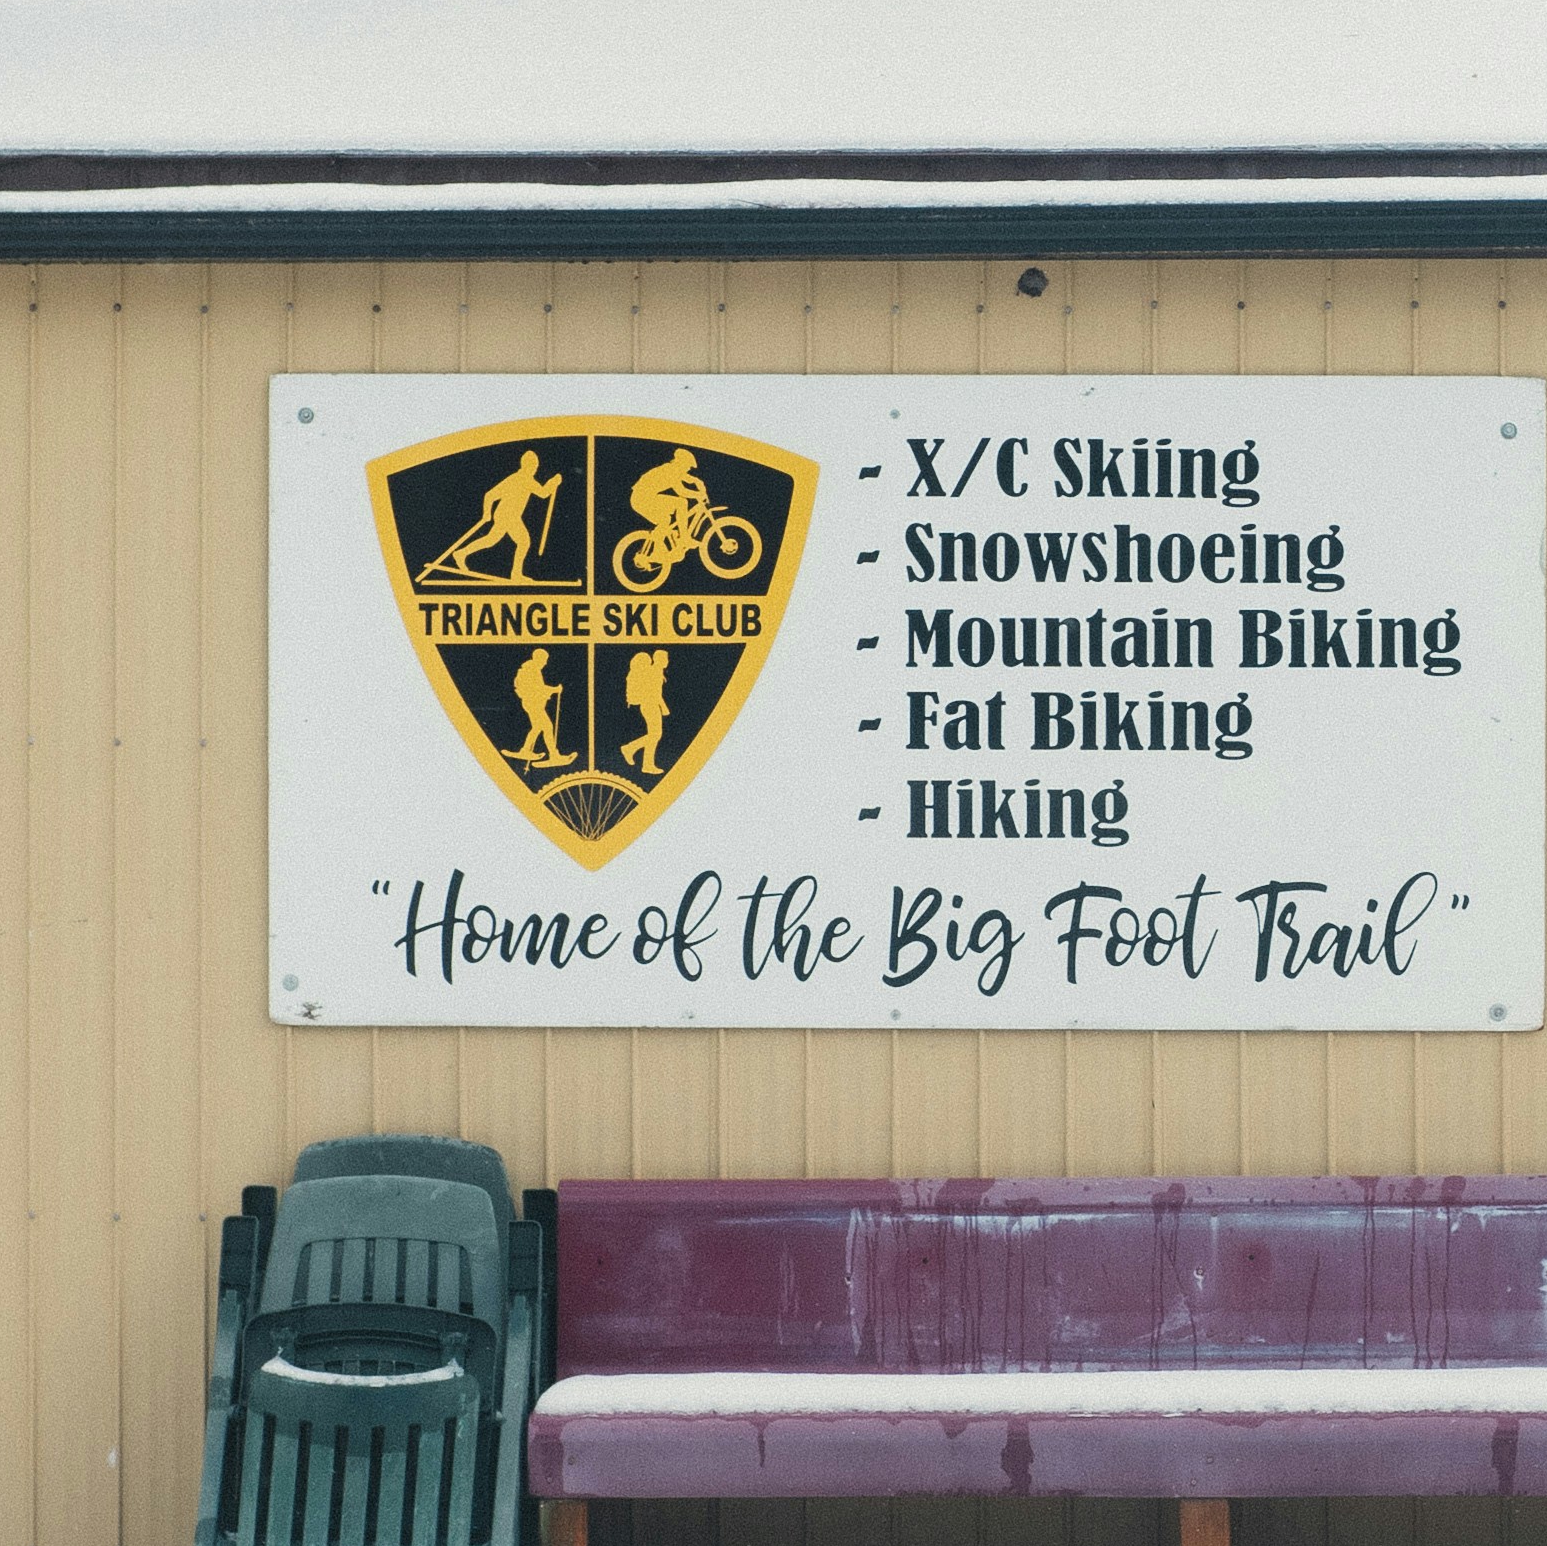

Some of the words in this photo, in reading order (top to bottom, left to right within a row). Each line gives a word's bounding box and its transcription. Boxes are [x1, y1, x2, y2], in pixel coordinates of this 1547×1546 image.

[906, 437, 1029, 498] X/C
[1053, 437, 1261, 506] Skiing
[905, 522, 1346, 593] Snowshoeing
[418, 602, 591, 637] TRIANGLE
[603, 602, 659, 637] SKI
[671, 602, 762, 638] CLUB
[904, 607, 1214, 668] Mountain
[1238, 608, 1462, 677] Biking
[905, 691, 1007, 751] Fat
[1030, 690, 1253, 761] Biking
[906, 778, 1130, 848] Hiking
[632, 869, 723, 983] of
[737, 875, 865, 983] the
[881, 885, 1026, 997] Big
[1044, 874, 1222, 985] Foot
